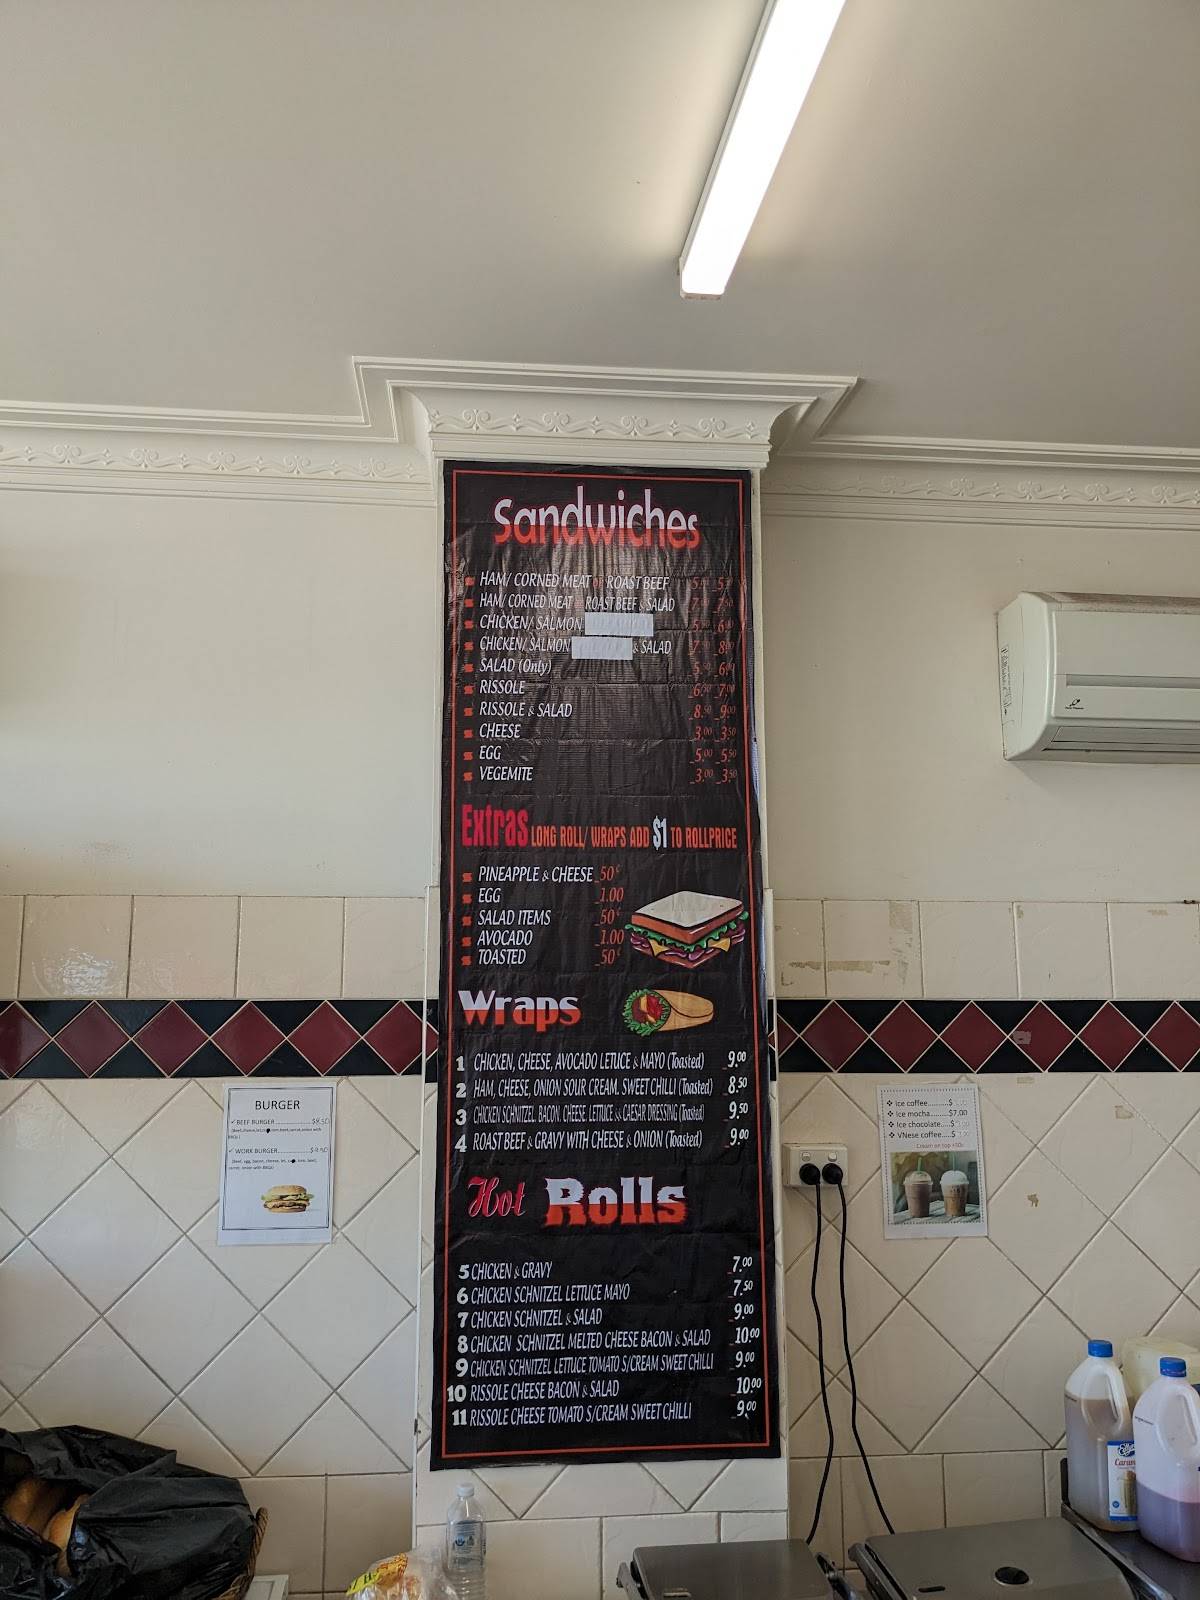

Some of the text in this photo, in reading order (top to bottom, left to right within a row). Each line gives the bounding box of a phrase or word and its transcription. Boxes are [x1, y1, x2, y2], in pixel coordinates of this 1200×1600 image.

[493, 485, 702, 549] Sandwiches
[480, 570, 670, 590] HAM/ CORNED MEAT ROAST BEEF
[480, 591, 507, 609] HAM/
[508, 593, 547, 609] CORNED
[548, 595, 574, 609] MEAT
[585, 596, 615, 611] ROAST
[615, 597, 639, 611] BEEF
[646, 597, 675, 612] SALAD
[480, 613, 583, 631] CHICKEN/ SALMON
[480, 635, 672, 655] CHICKEN/ SALMON SALAD
[480, 657, 552, 676] SALAD (Only)
[480, 679, 526, 695] RISSOLE
[480, 701, 526, 716] RISSOLE
[536, 703, 573, 718] SALAD
[480, 722, 521, 738] CHEESE
[479, 745, 502, 760] EGG
[480, 766, 534, 781] VEGEMITE
[461, 804, 529, 847] Extras
[531, 826, 557, 848] LONG
[591, 826, 628, 848] WRAPS
[629, 826, 650, 848] ADD
[652, 815, 667, 850] $1
[670, 827, 682, 849] TO
[478, 865, 594, 883] PINEAPPLE & CHEESE
[478, 887, 501, 903] EGG
[478, 909, 551, 926] SALAD ITEMS
[477, 929, 533, 946] AVOCADO
[478, 948, 527, 965] TOASTED
[457, 990, 582, 1033] Wraps
[456, 1055, 465, 1071] 1
[474, 1052, 516, 1072] CHICKEN,
[518, 1051, 553, 1072] CHEESE,
[555, 1052, 598, 1070] AVOCADO
[640, 1051, 666, 1070] MAYO
[667, 1052, 705, 1070] (Toasted)
[456, 1082, 467, 1098] 2
[473, 1078, 496, 1099] HAM,
[498, 1078, 531, 1099] CHEESE,
[533, 1078, 562, 1097] ONION
[563, 1078, 587, 1097] SOUR
[621, 1078, 650, 1096] SWEET
[650, 1076, 677, 1097] CHILLI
[678, 1077, 713, 1097] (Toasted)
[255, 1099, 301, 1111] BURGER
[906, 1099, 928, 1107] coffee
[455, 1109, 467, 1125] 3
[473, 1105, 502, 1124] CHICKEN
[622, 1103, 647, 1122] CAESAR
[647, 1103, 678, 1122] DRESSING
[678, 1103, 705, 1122] (Toasted)
[908, 1120, 941, 1128] chocolate
[454, 1134, 467, 1152] 4
[473, 1132, 504, 1150] ROAST
[504, 1131, 526, 1150] BEEF
[535, 1130, 565, 1150] GRAVY
[566, 1129, 590, 1150] WITH
[591, 1129, 624, 1149] CHEESE
[633, 1130, 664, 1148] ONION
[665, 1130, 703, 1149] (Toasted)
[920, 1131, 942, 1139] coffee
[468, 1176, 688, 1227] Hot Rolls
[458, 1264, 470, 1280] 5
[471, 1262, 512, 1281] CHICKEN
[522, 1261, 553, 1279] GRAVY
[456, 1287, 469, 1304] 6
[471, 1286, 513, 1305] CHICKEN
[514, 1284, 563, 1304] SCHNITZEL
[565, 1284, 602, 1301] LETTUCE
[603, 1283, 631, 1300] MAYO
[457, 1312, 469, 1328] 7
[470, 1310, 513, 1329] CHICKEN
[513, 1308, 563, 1328] SCHNITZEL
[572, 1308, 603, 1325] SALAD
[457, 1335, 469, 1354] 8
[470, 1334, 512, 1354] CHICKEN
[515, 1333, 565, 1352] SCHNITZEL
[568, 1331, 603, 1350] MELTED
[604, 1329, 640, 1349] CHEESE
[640, 1330, 673, 1348] BACON
[681, 1328, 711, 1346] SALAD
[455, 1358, 469, 1377] 9
[470, 1358, 507, 1378] CHICKEN
[507, 1357, 553, 1377] SCHNITZEL
[553, 1356, 587, 1374] LETTUCE
[588, 1355, 620, 1373] TOMATO
[620, 1353, 660, 1373] S/CREAM
[660, 1353, 688, 1372] SWEET
[688, 1352, 714, 1371] CHILLI
[446, 1384, 467, 1403] 10
[470, 1382, 509, 1402] RISSOLE
[510, 1380, 547, 1401] CHEESE
[547, 1380, 581, 1399] BACON
[589, 1379, 620, 1398] SALAD
[451, 1408, 467, 1426] 11
[469, 1407, 510, 1427] RISSOLE
[510, 1405, 547, 1426] CHEESE
[547, 1404, 584, 1424] TOMATO
[585, 1403, 629, 1423] S/CREAM
[630, 1402, 663, 1421] SWEET
[663, 1400, 692, 1420] CHILLI
